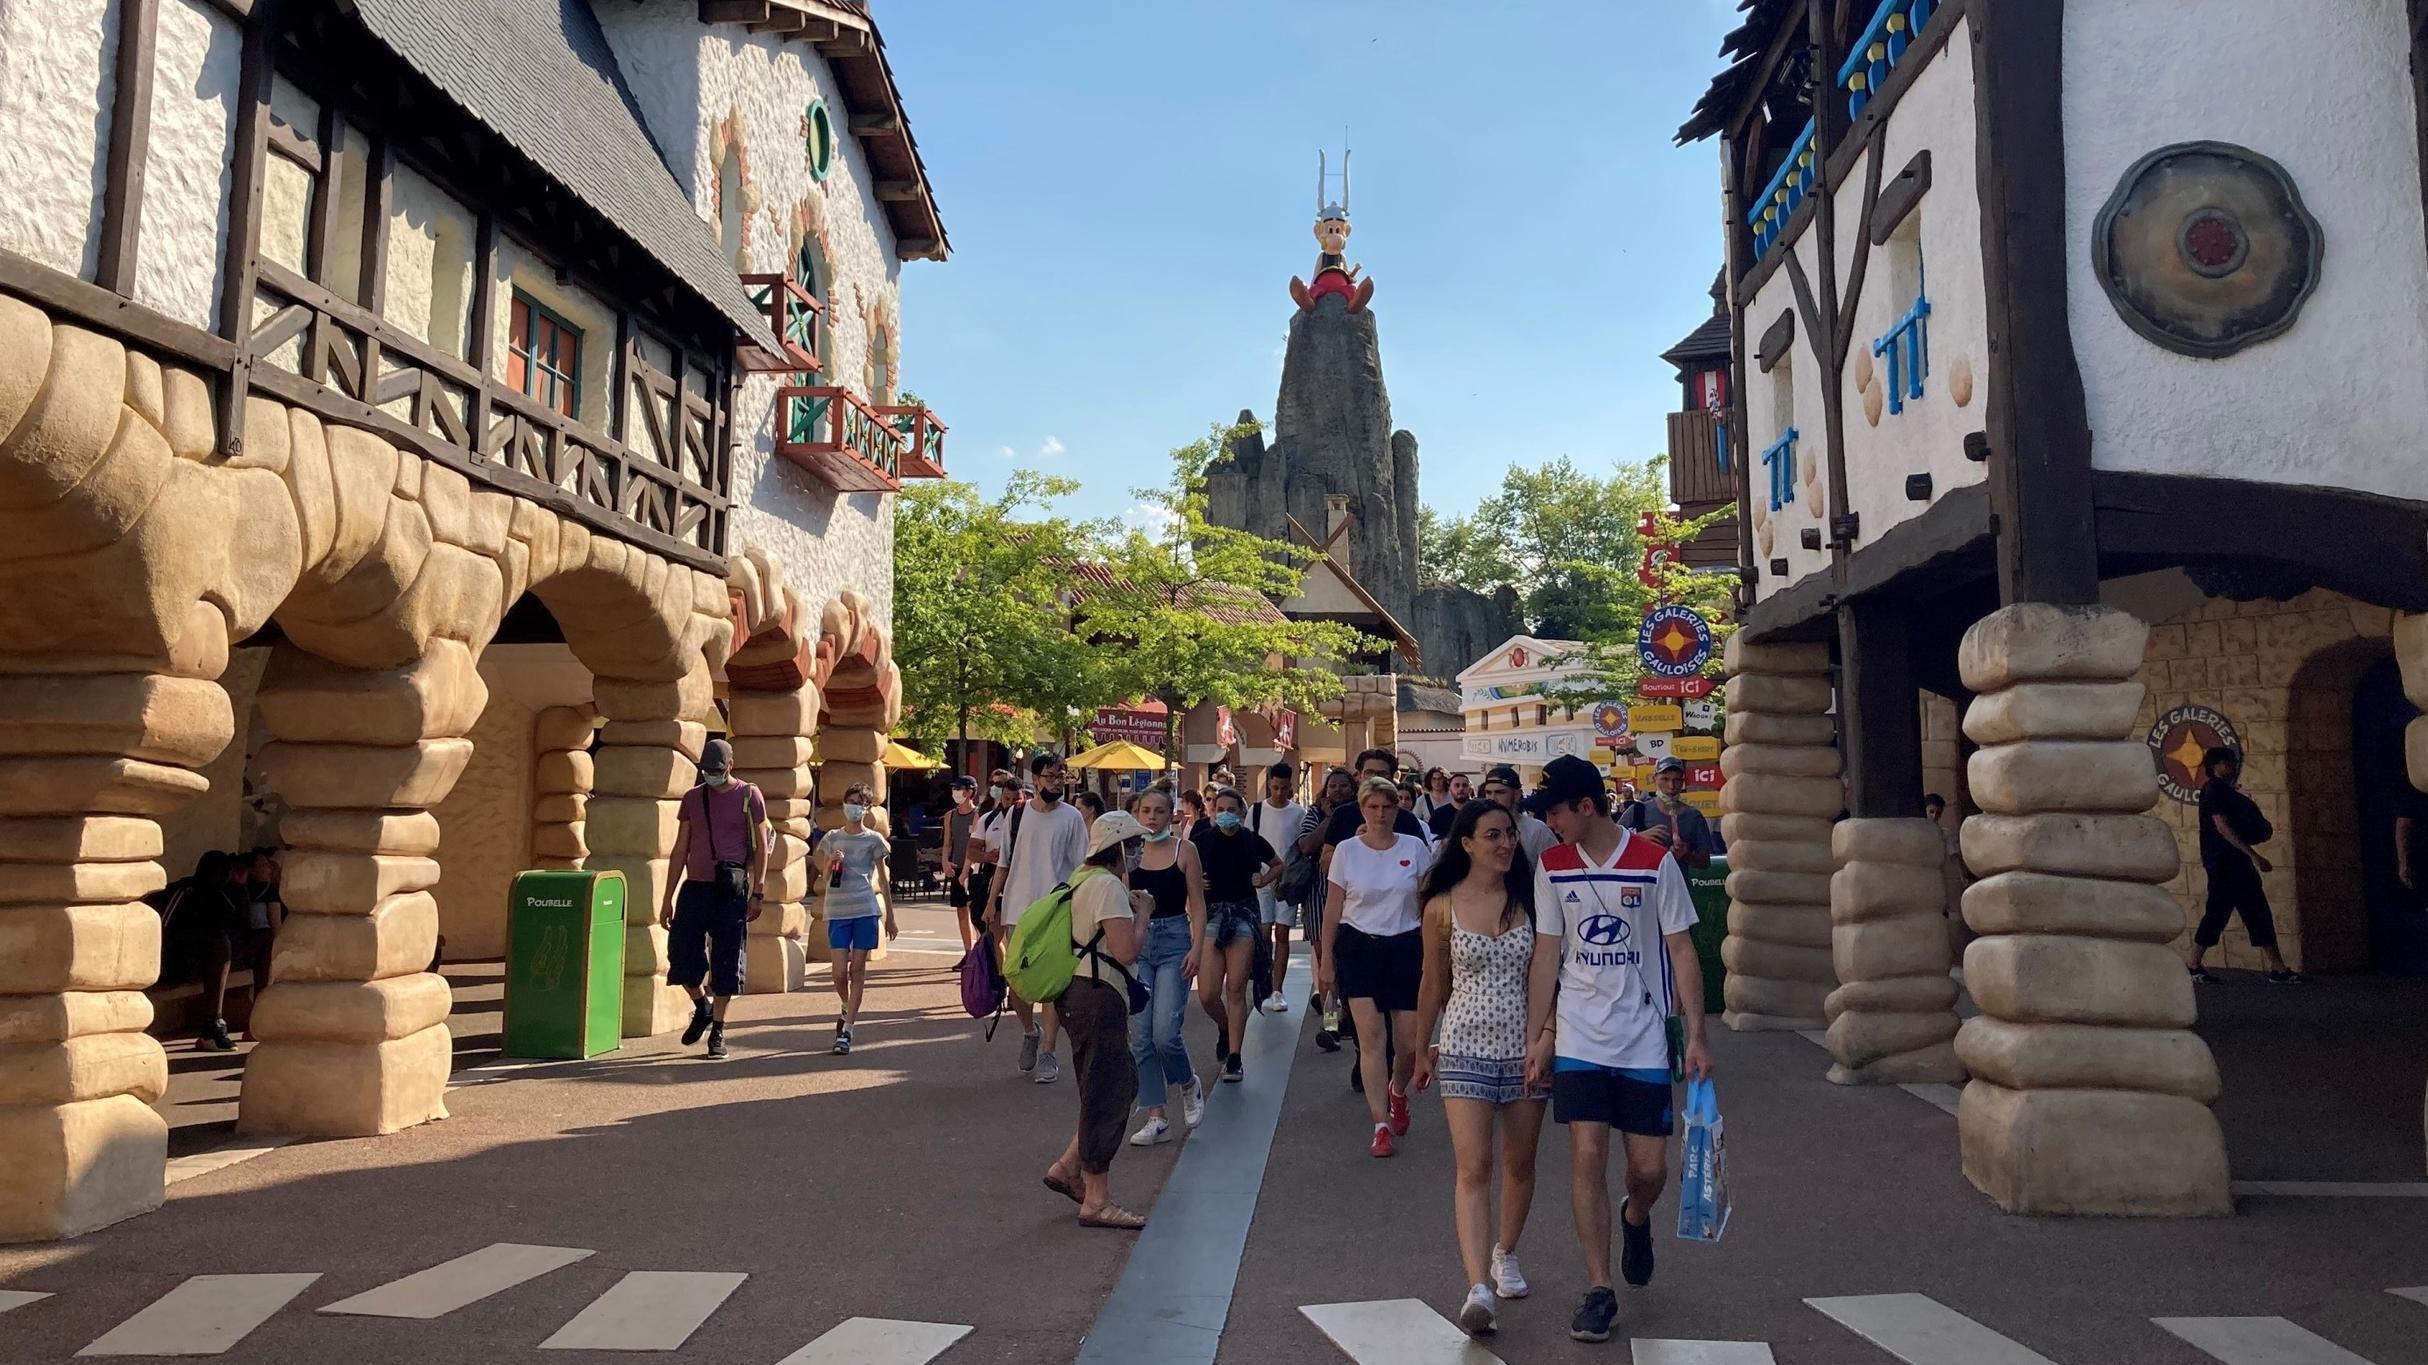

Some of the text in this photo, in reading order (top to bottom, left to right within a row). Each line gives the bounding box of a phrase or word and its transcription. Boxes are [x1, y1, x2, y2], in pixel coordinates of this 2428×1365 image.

[1641, 607, 1709, 644] LES GALERIES
[1643, 649, 1707, 675] GAULOISES
[2148, 707, 2236, 749] LES GALERIES
[1649, 739, 1664, 748] BD
[2157, 773, 2201, 802] GAULO
[1691, 878, 1725, 887] POUBELL
[1576, 950, 1640, 966] HYUNDAI
[1688, 1144, 1699, 1178] PARC
